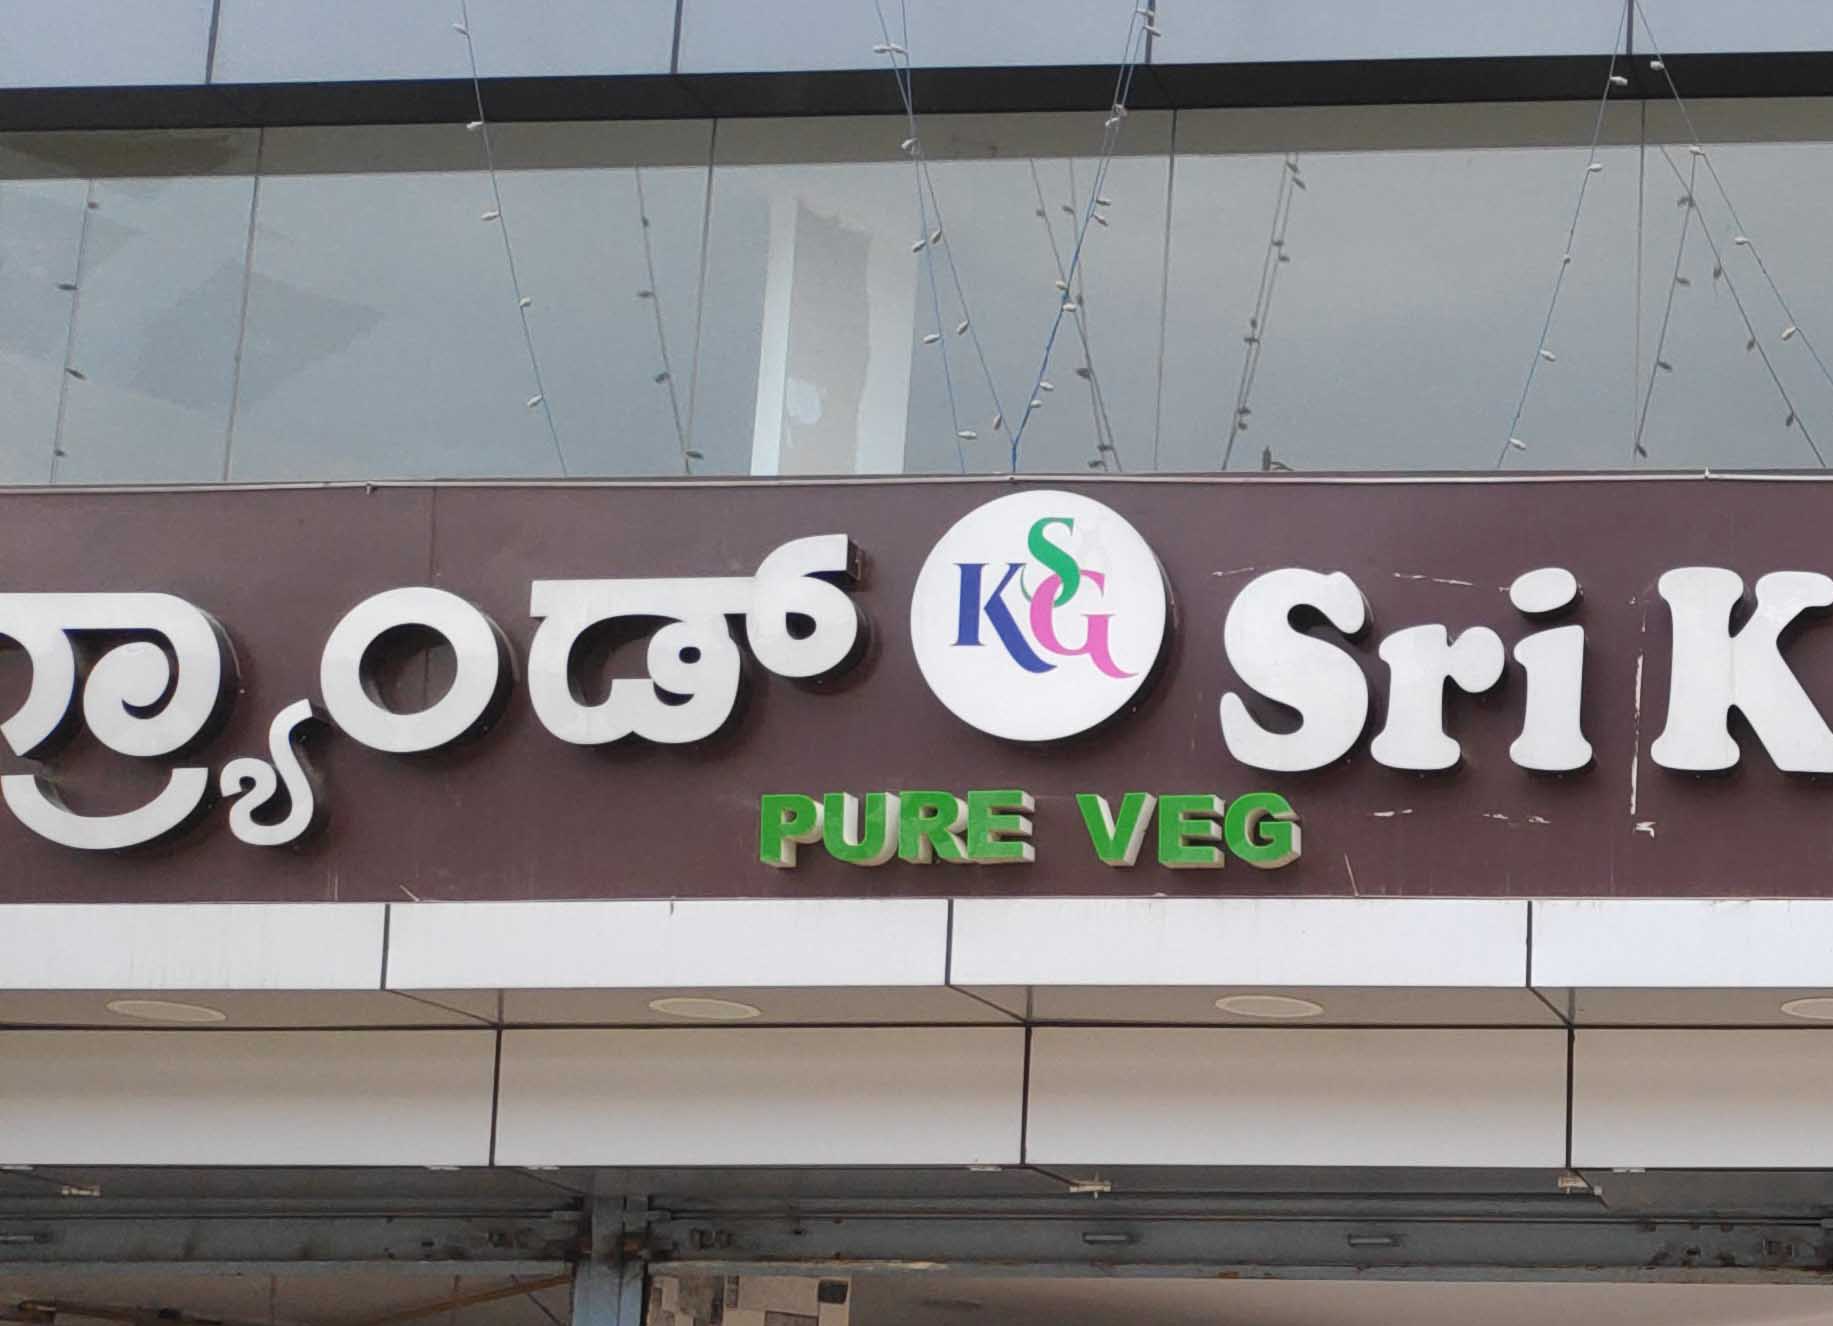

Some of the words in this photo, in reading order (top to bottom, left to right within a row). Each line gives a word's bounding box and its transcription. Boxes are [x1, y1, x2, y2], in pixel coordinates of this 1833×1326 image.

[1220, 566, 1593, 772] Sri
[760, 790, 1035, 868] PURE
[1076, 792, 1302, 869] VEG
